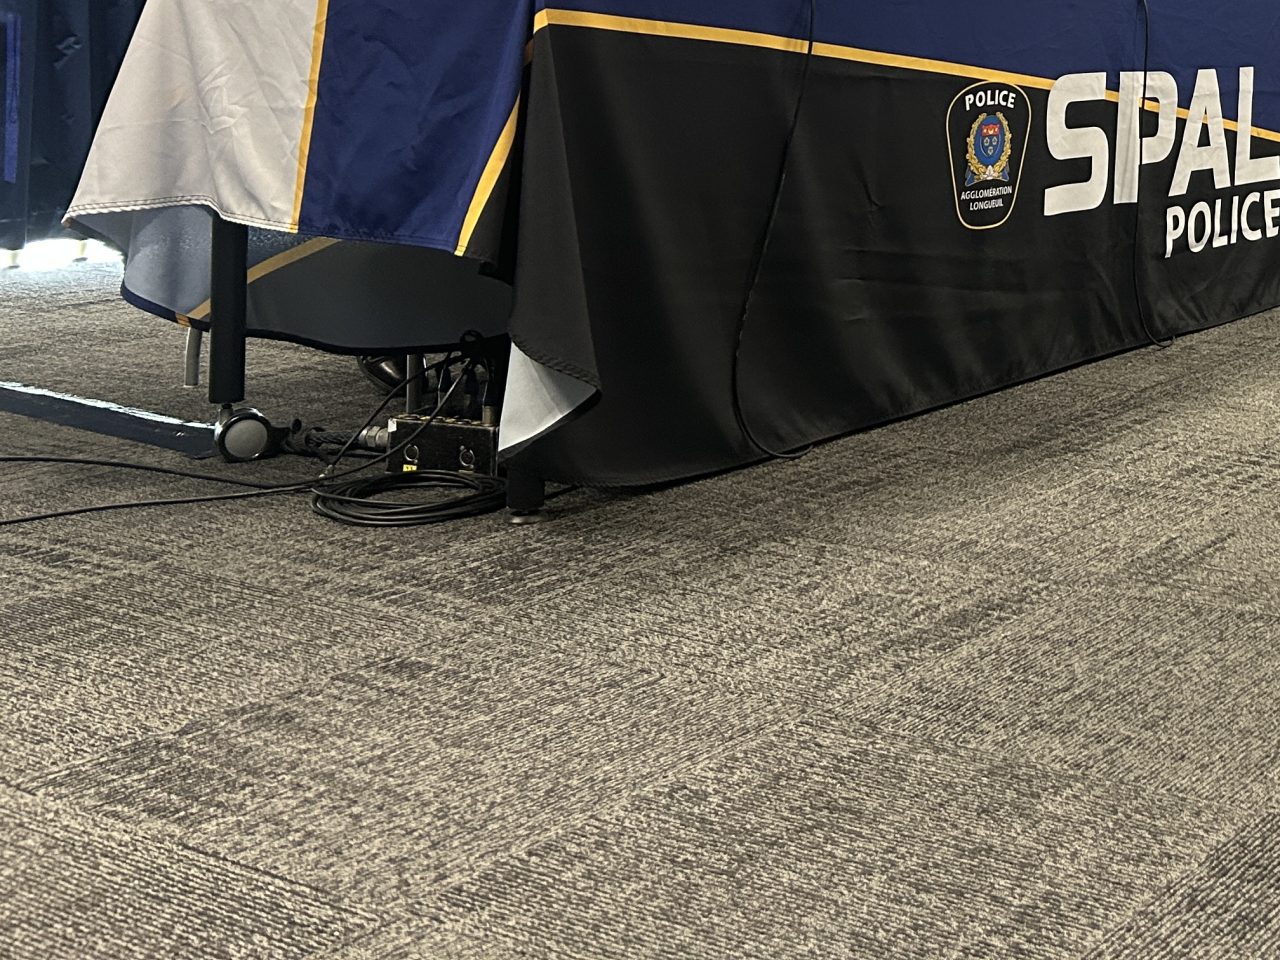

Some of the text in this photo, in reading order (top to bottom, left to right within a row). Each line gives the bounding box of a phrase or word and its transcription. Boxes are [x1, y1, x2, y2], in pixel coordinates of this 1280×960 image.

[965, 90, 1017, 111] POLICE
[1044, 66, 1280, 216] SPAL
[960, 186, 1013, 200] AGGLOMÉRATION
[969, 198, 1004, 211] LONGUEUIL
[1165, 189, 1280, 259] POLICE
